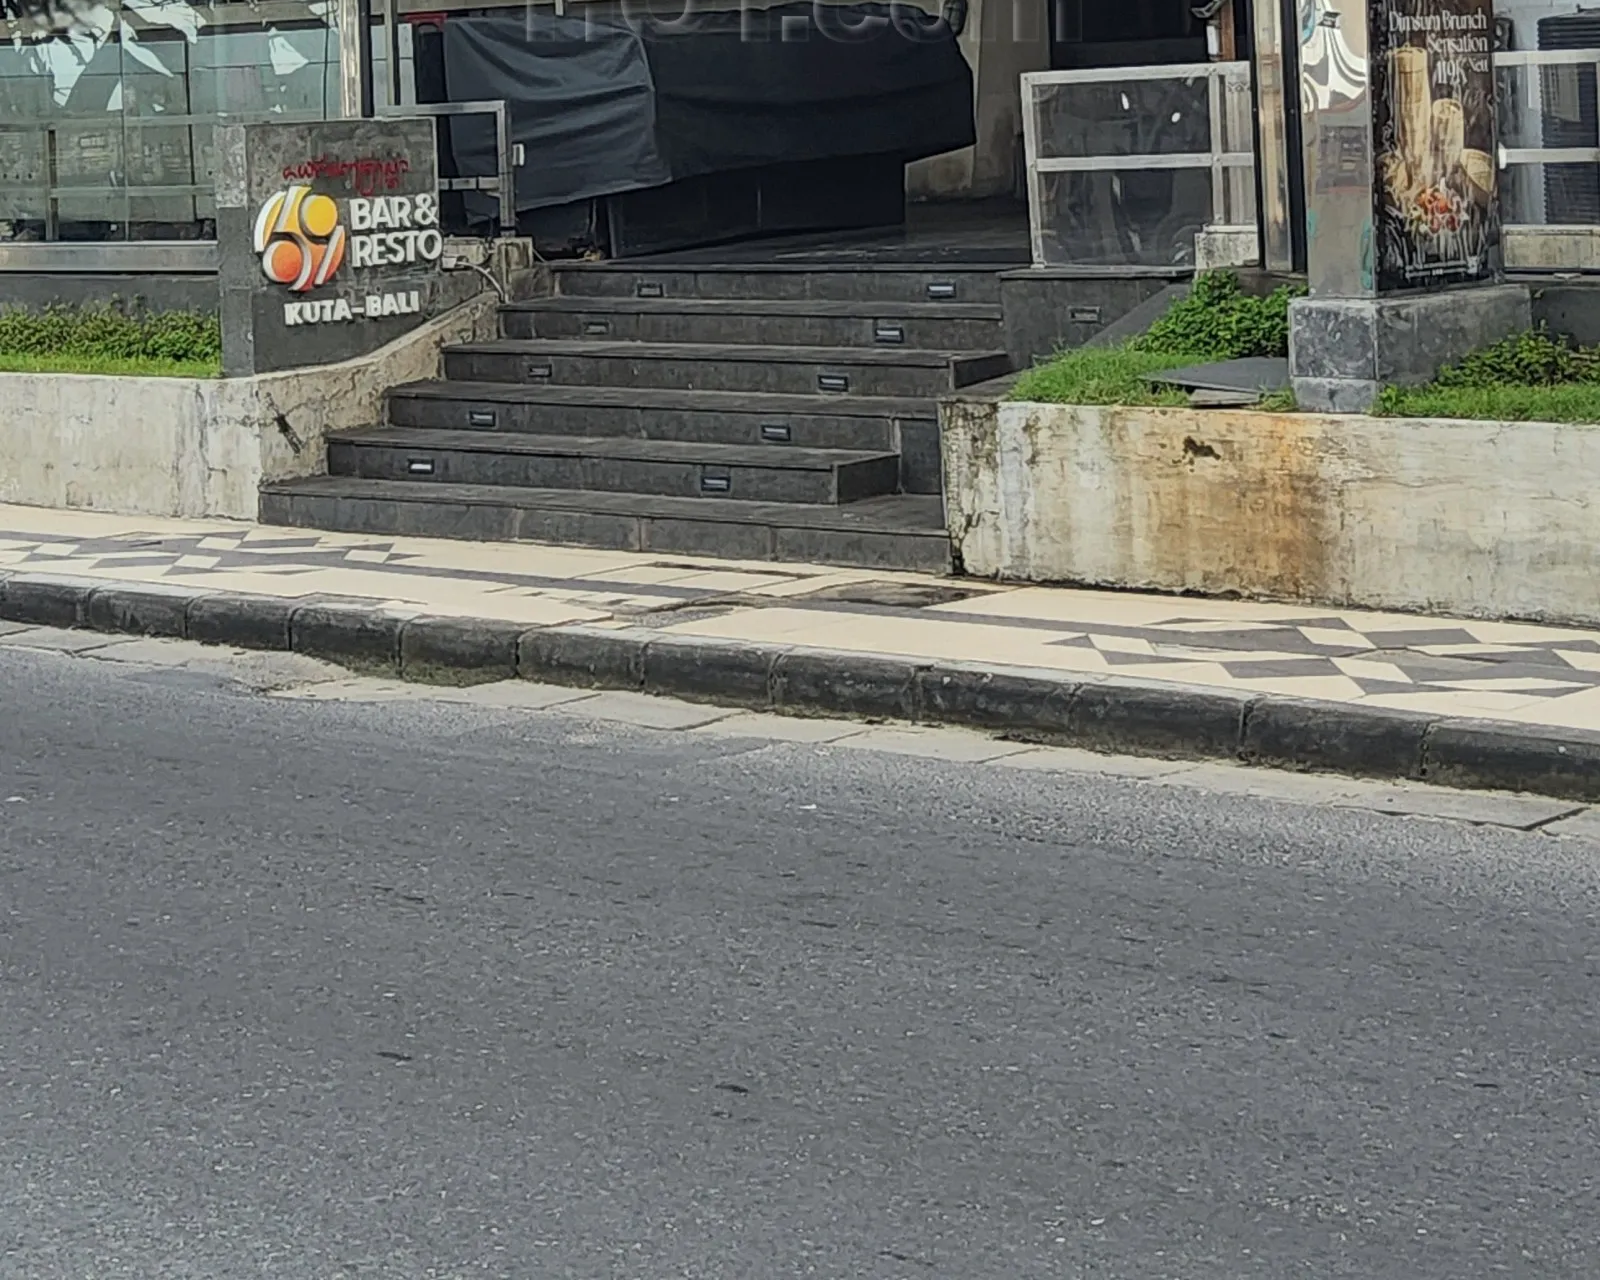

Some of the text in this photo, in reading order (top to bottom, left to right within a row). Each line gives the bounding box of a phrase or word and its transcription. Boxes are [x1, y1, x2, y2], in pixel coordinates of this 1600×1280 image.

[1389, 7, 1487, 32] Dimsum Brunch
[1426, 32, 1488, 56] Sensation
[350, 229, 443, 268] RESTO
[283, 290, 421, 326] KUTA-BALI
